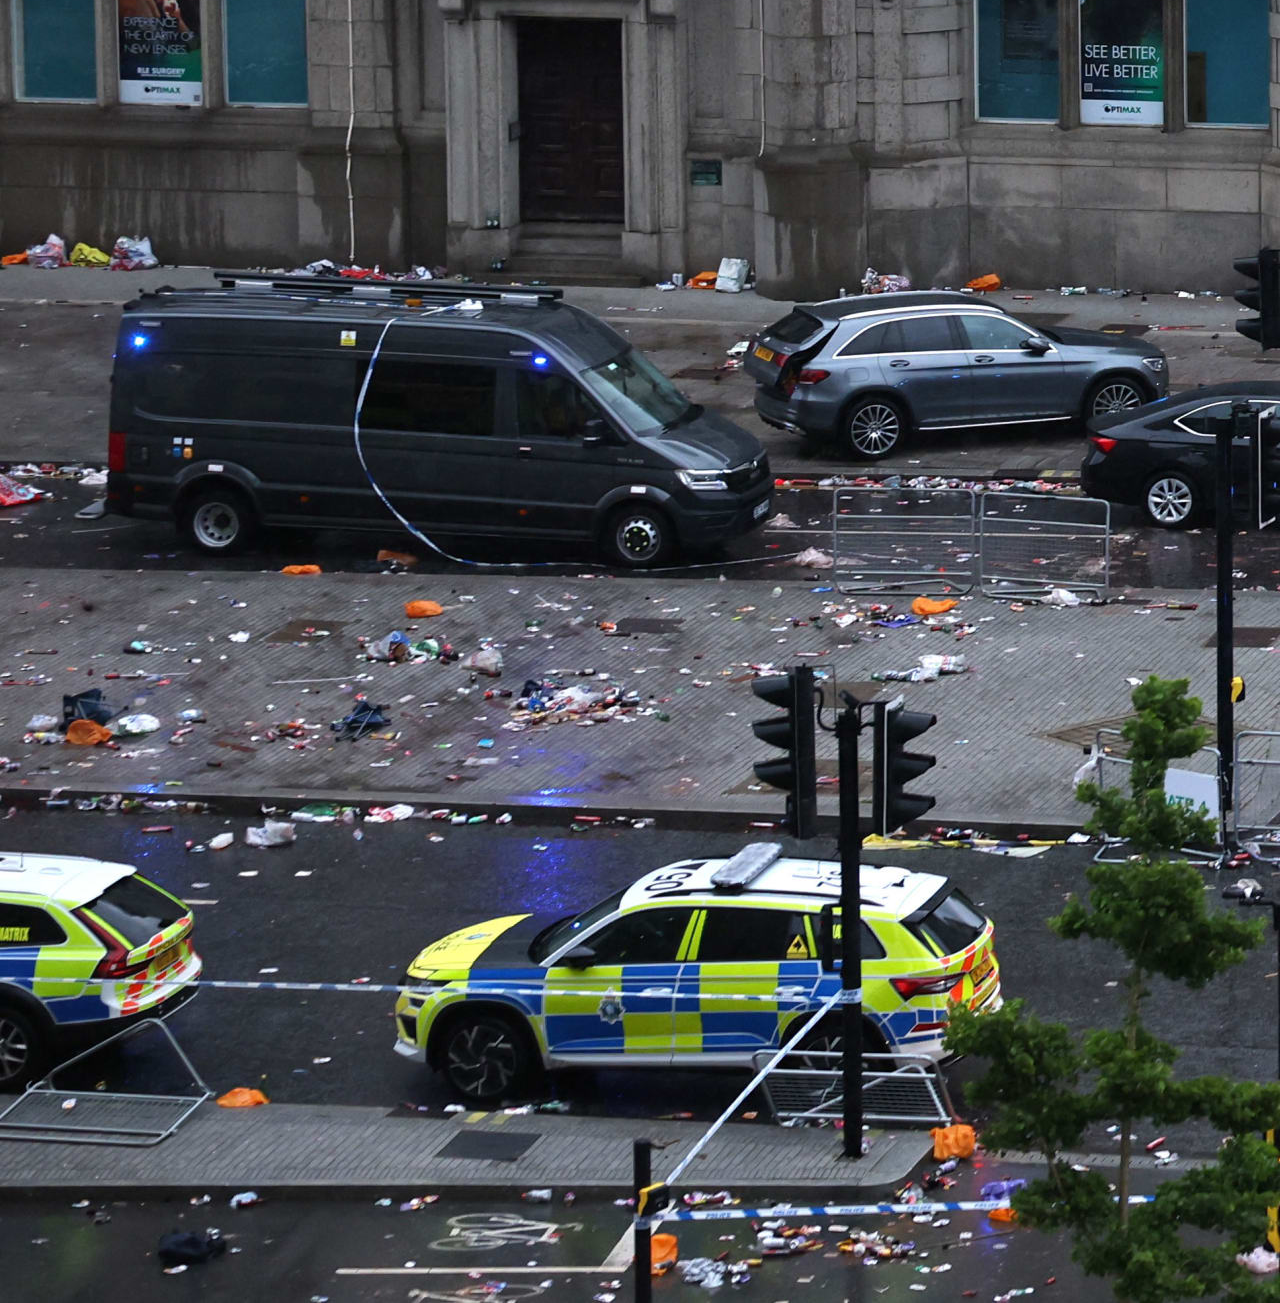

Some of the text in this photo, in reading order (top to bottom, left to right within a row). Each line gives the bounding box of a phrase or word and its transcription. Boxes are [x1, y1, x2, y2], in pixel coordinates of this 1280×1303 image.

[123, 17, 177, 28] EXPERIENCE
[124, 30, 194, 41] THE CLARITY OF
[124, 44, 151, 54] NEW
[1085, 45, 1160, 62] SEE BETTER,
[152, 67, 185, 75] SURGERY
[1085, 63, 1158, 79] LIVE BETTER
[1103, 104, 1141, 114] OPTIMAX
[645, 867, 692, 892] 05
